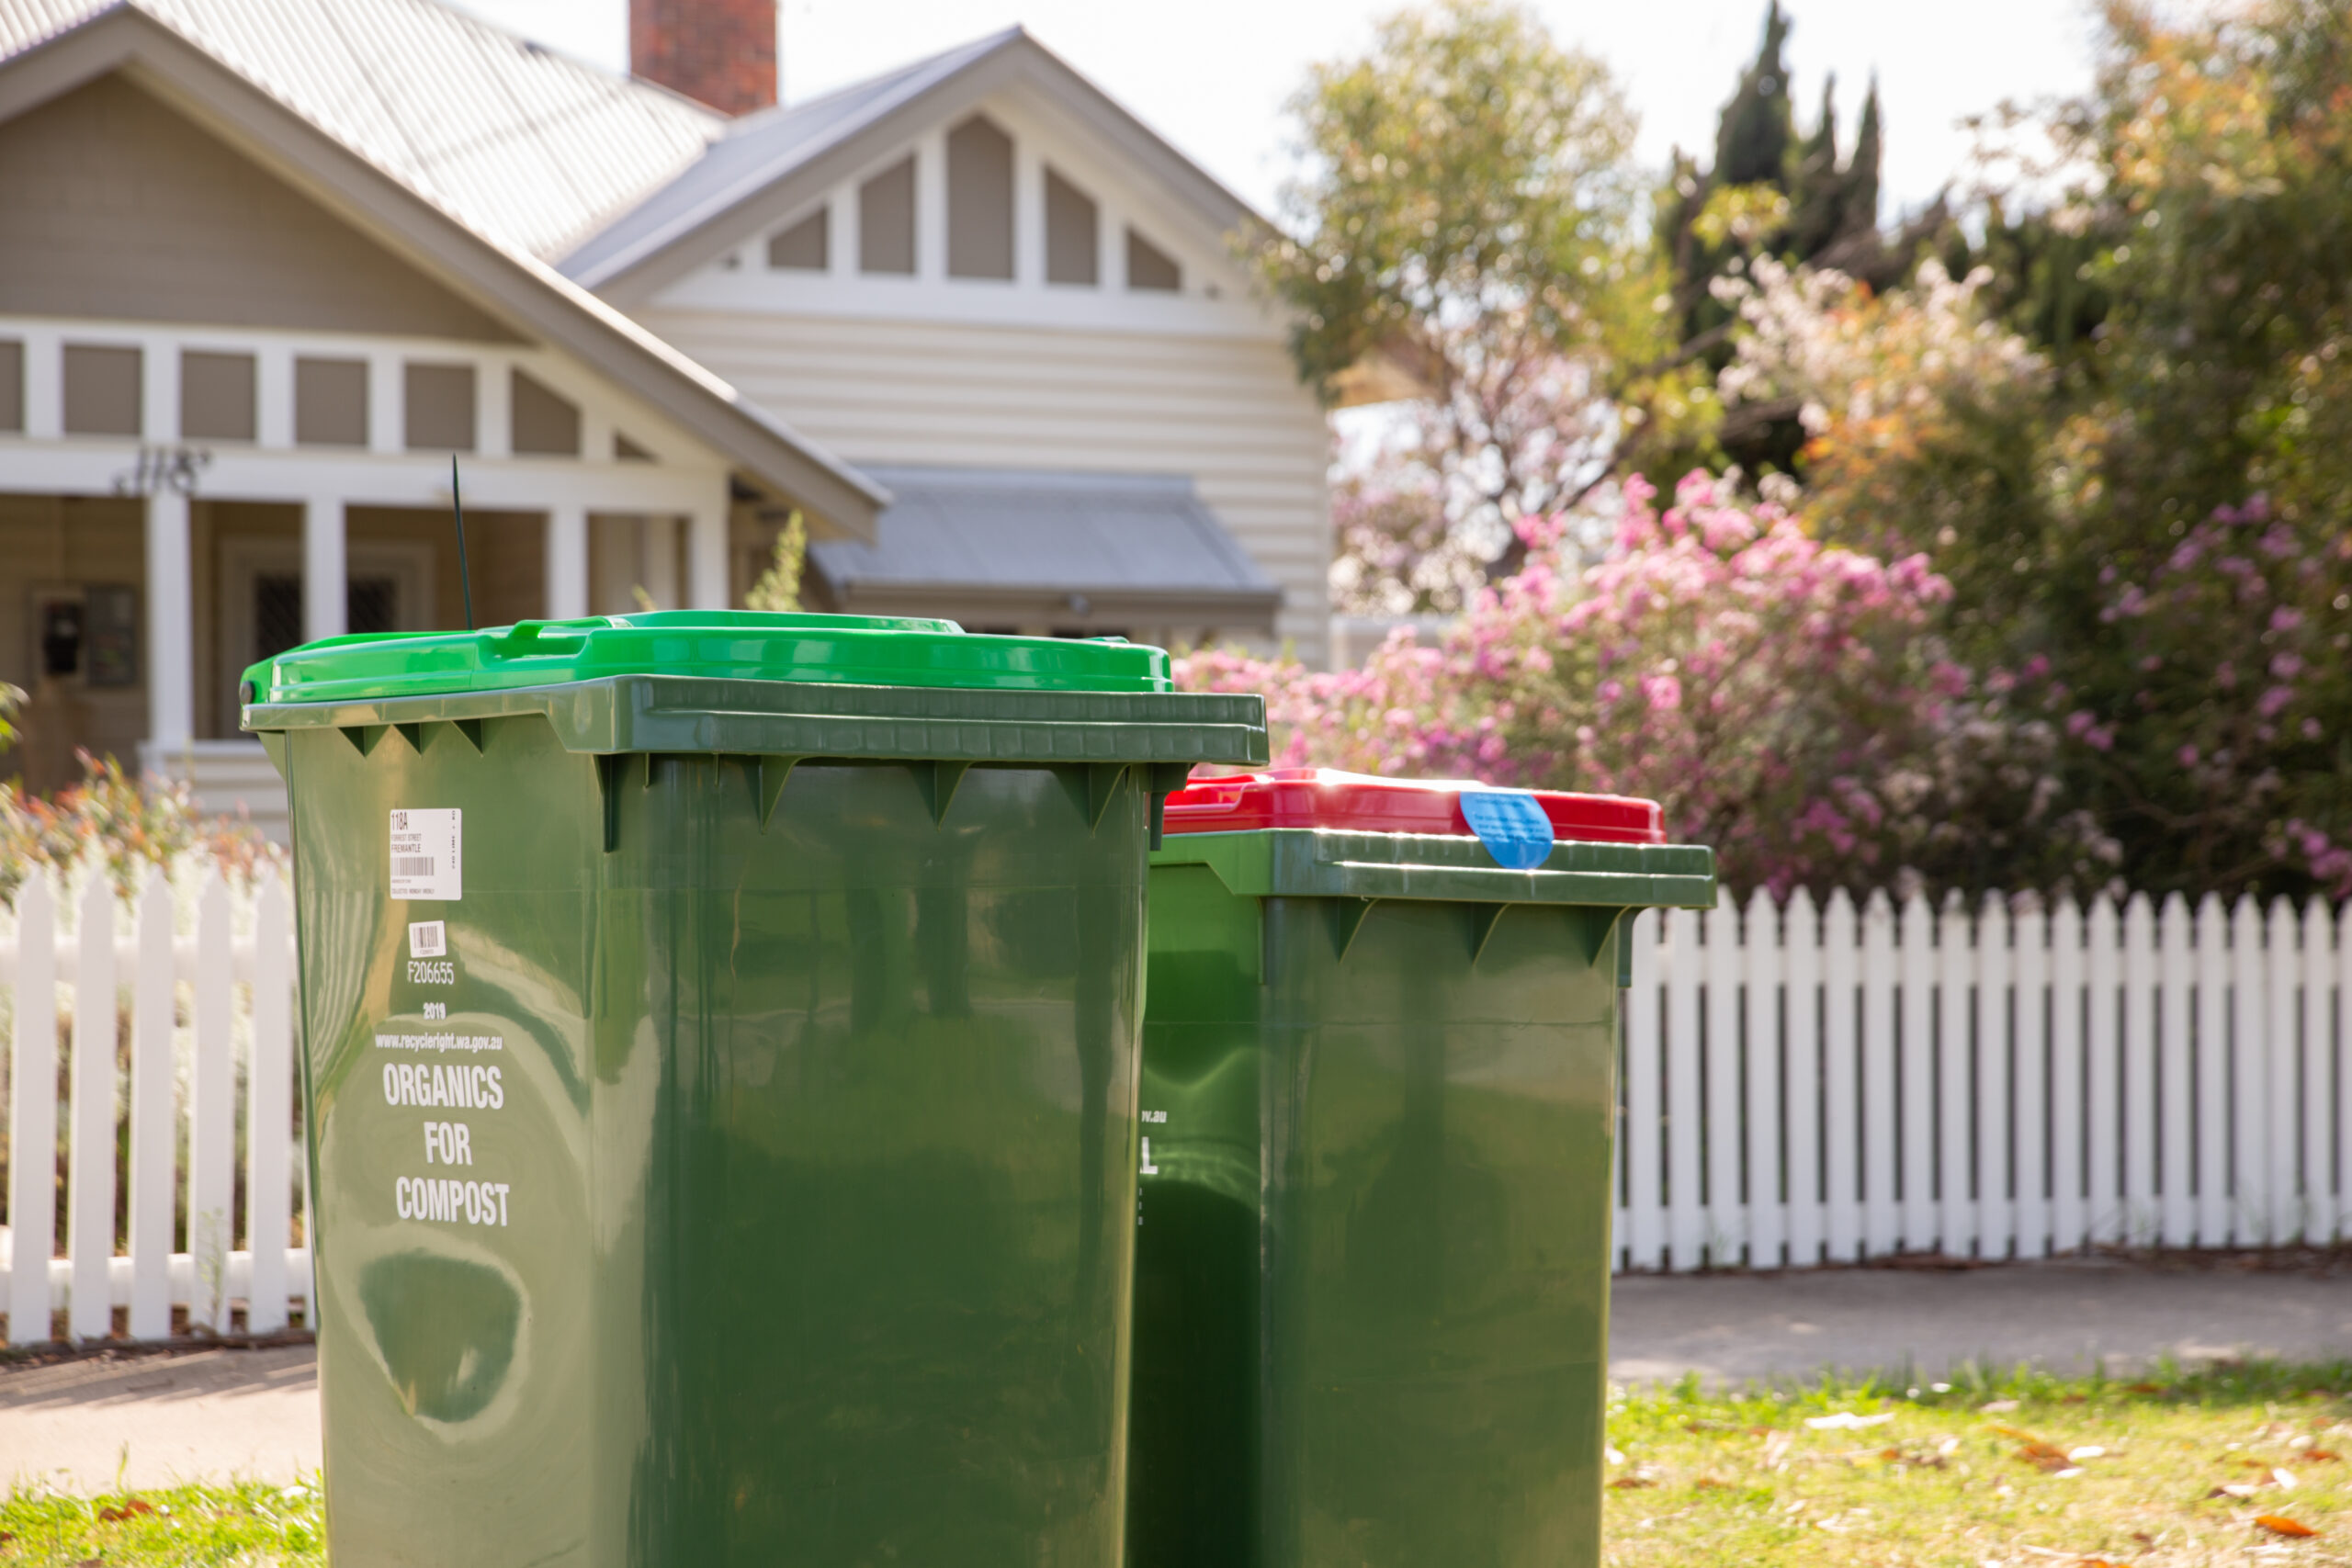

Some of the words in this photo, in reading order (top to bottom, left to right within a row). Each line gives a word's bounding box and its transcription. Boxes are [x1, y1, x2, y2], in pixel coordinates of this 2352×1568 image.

[391, 812, 408, 830] 118A
[391, 843, 421, 852] FREMANTLE
[408, 833, 422, 841] STREET
[407, 961, 455, 985] F206655
[423, 1002, 447, 1021] 2019
[375, 1032, 503, 1054] www.recycleright.wa.gov.au
[382, 1062, 504, 1110] ORGANICS
[424, 1121, 473, 1166] FOR
[395, 1176, 510, 1227] COMPOST
